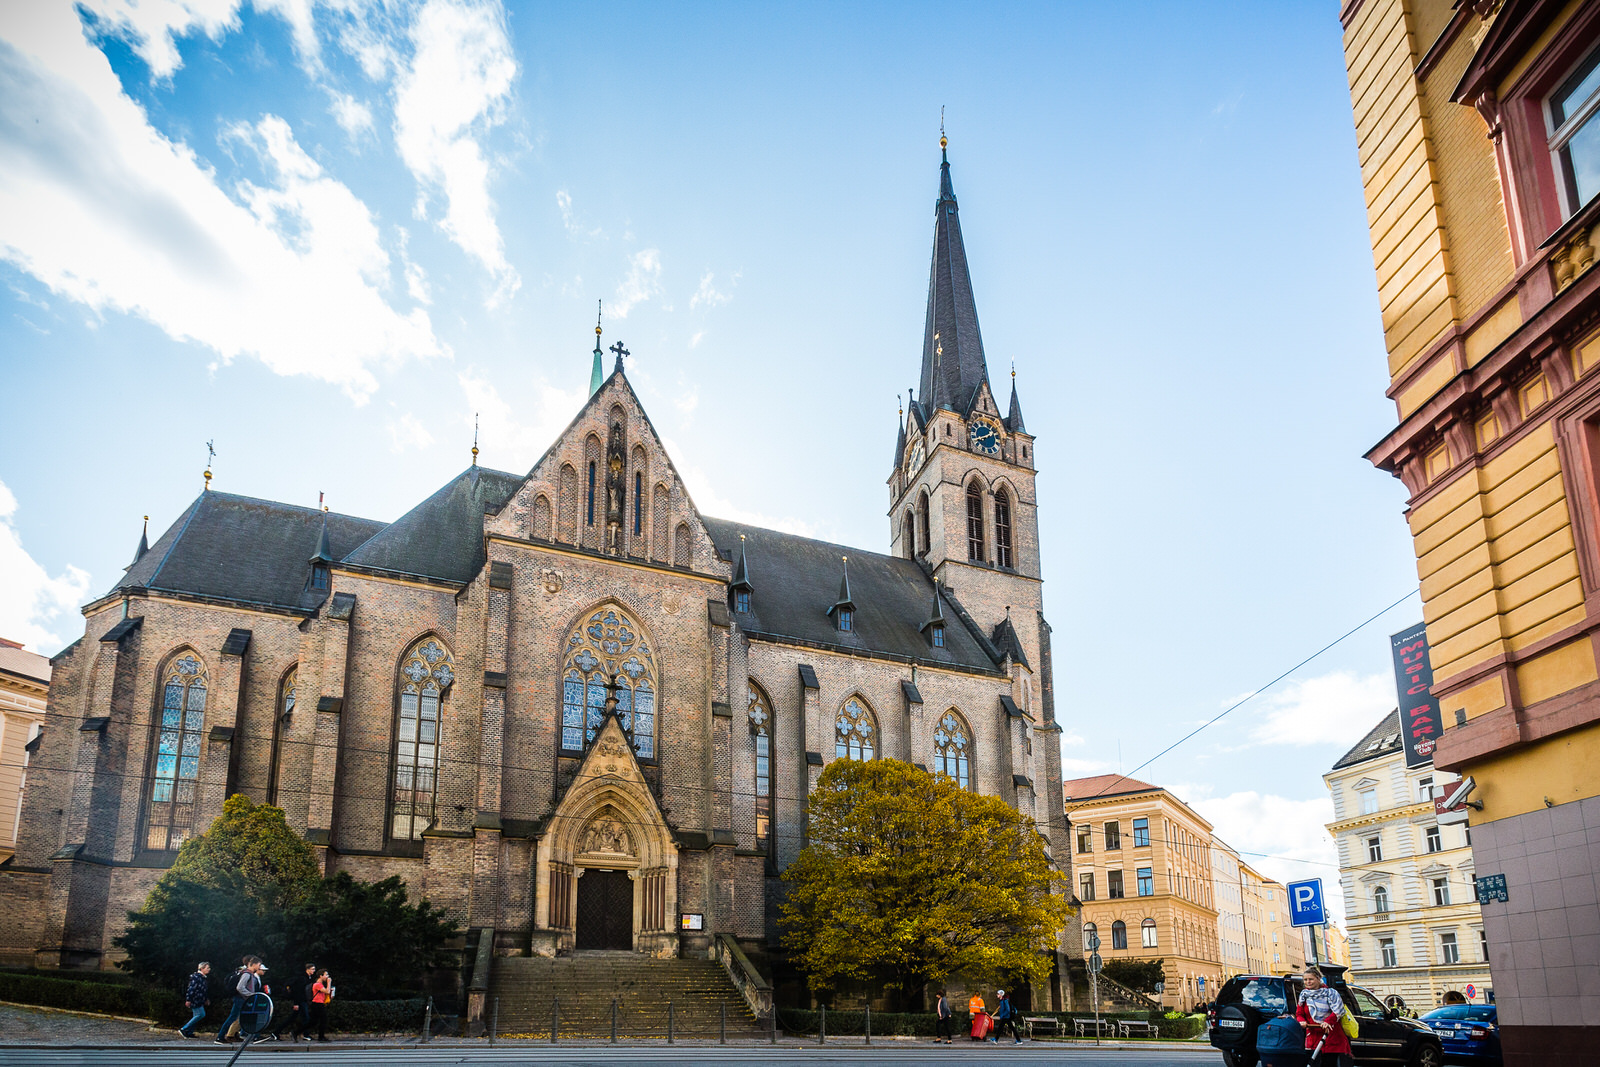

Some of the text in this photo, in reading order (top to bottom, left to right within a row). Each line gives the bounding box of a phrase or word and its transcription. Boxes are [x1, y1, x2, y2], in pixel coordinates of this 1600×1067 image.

[1402, 630, 1426, 643] PANTERA
[1400, 640, 1427, 695] MUSIC
[1410, 704, 1434, 738] BAR
[1413, 740, 1435, 750] Havana
[1418, 746, 1432, 754] Club
[1294, 886, 1315, 913] P
